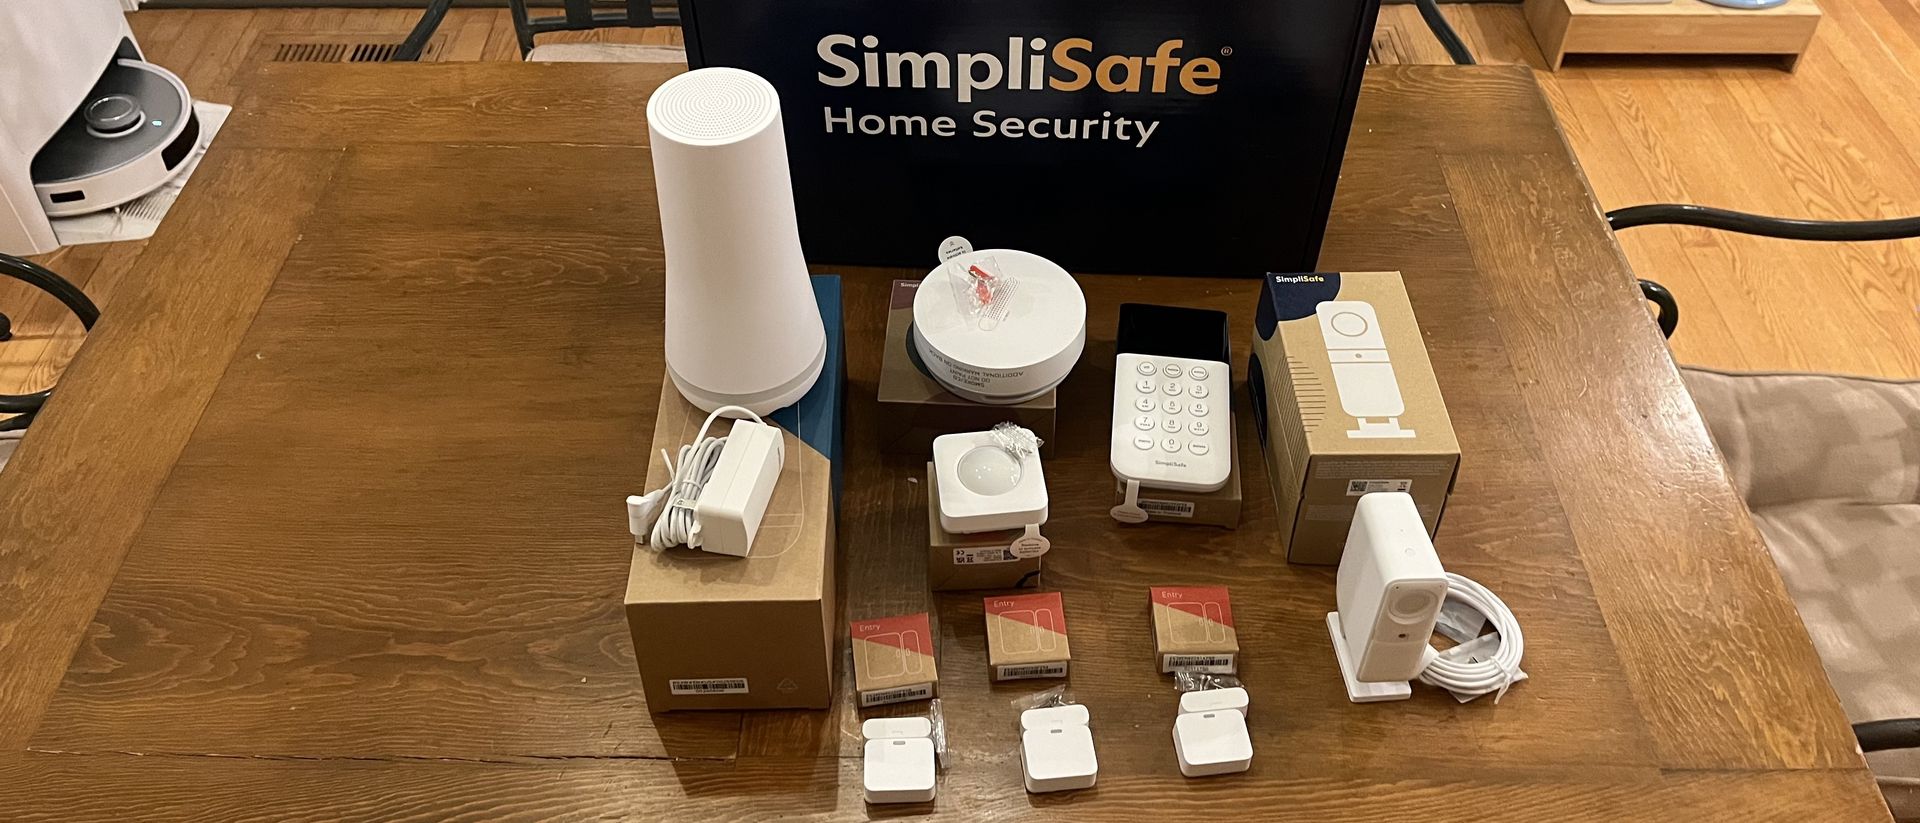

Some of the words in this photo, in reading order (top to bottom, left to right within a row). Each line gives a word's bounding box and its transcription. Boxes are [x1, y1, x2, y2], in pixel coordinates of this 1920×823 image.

[817, 34, 1222, 103] SimpliSafe
[824, 106, 956, 137] Home
[973, 110, 1160, 148] Security
[1275, 275, 1325, 285] SimpliSafe
[952, 364, 981, 376] MARKING
[1161, 591, 1183, 600] Entry
[993, 600, 1015, 608] Entry
[859, 624, 881, 632] Entry
